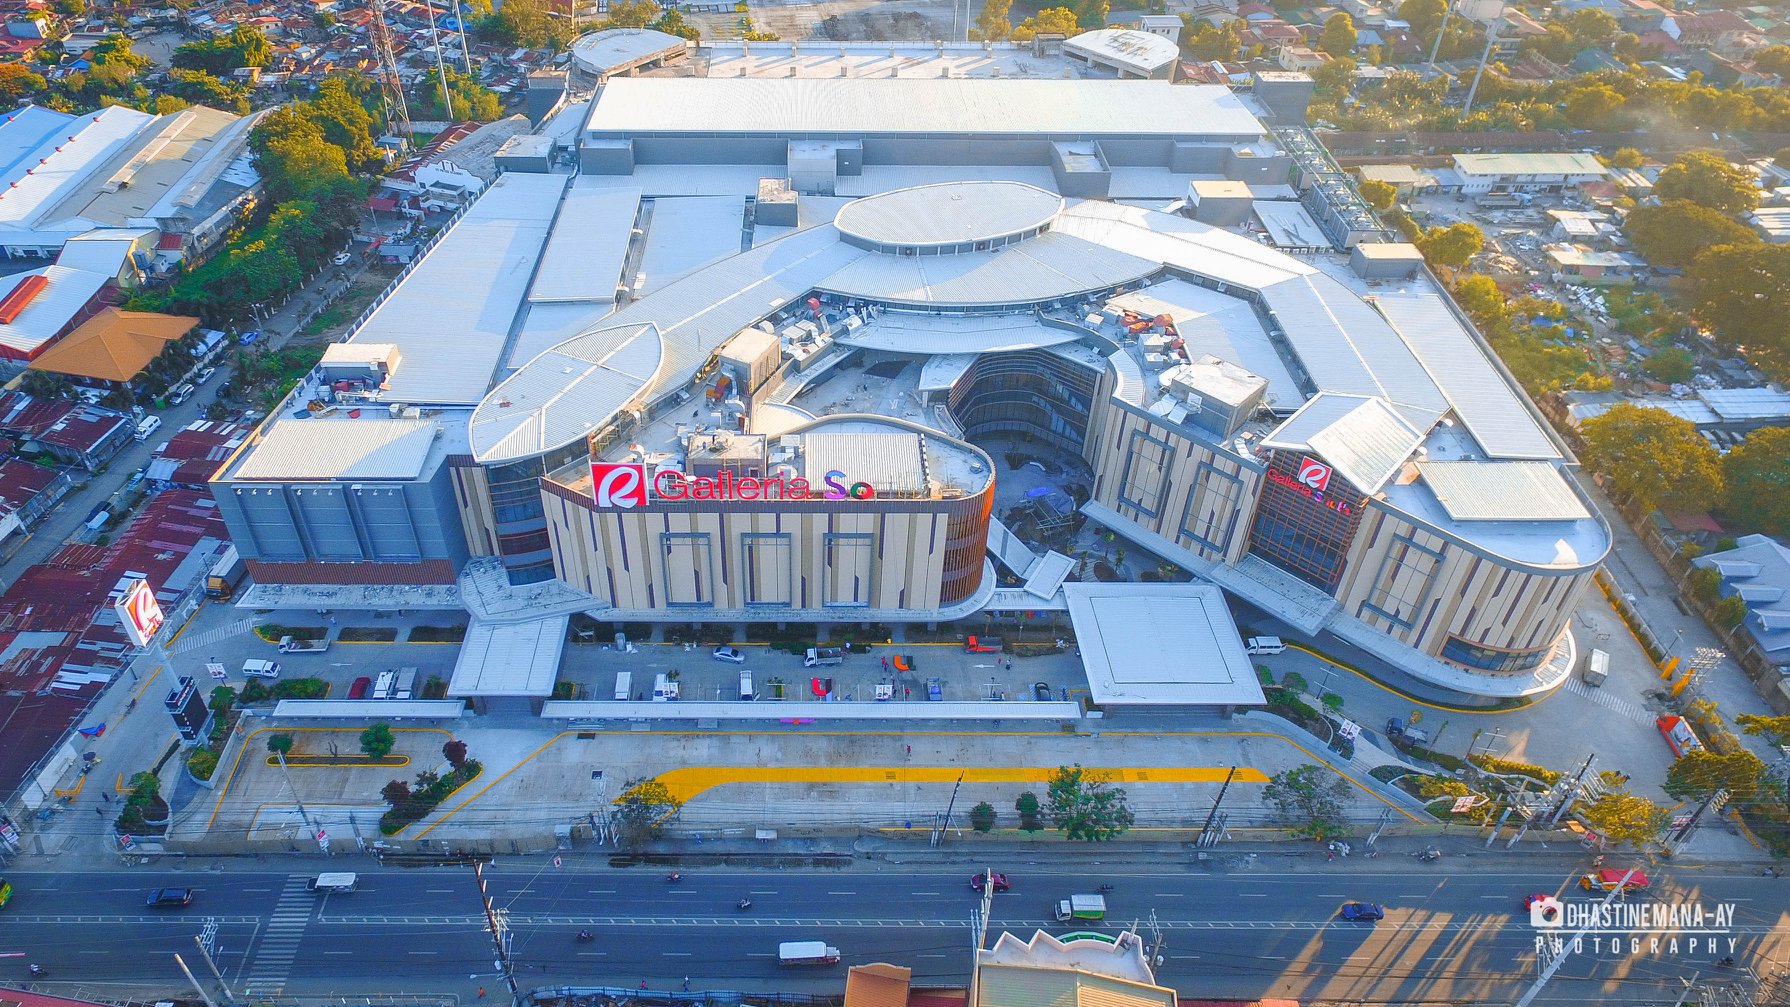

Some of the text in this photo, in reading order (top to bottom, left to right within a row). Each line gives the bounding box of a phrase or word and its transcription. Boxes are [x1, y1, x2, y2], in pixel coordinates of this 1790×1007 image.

[656, 469, 874, 500] Galleria So
[1267, 468, 1312, 497] Galleria
